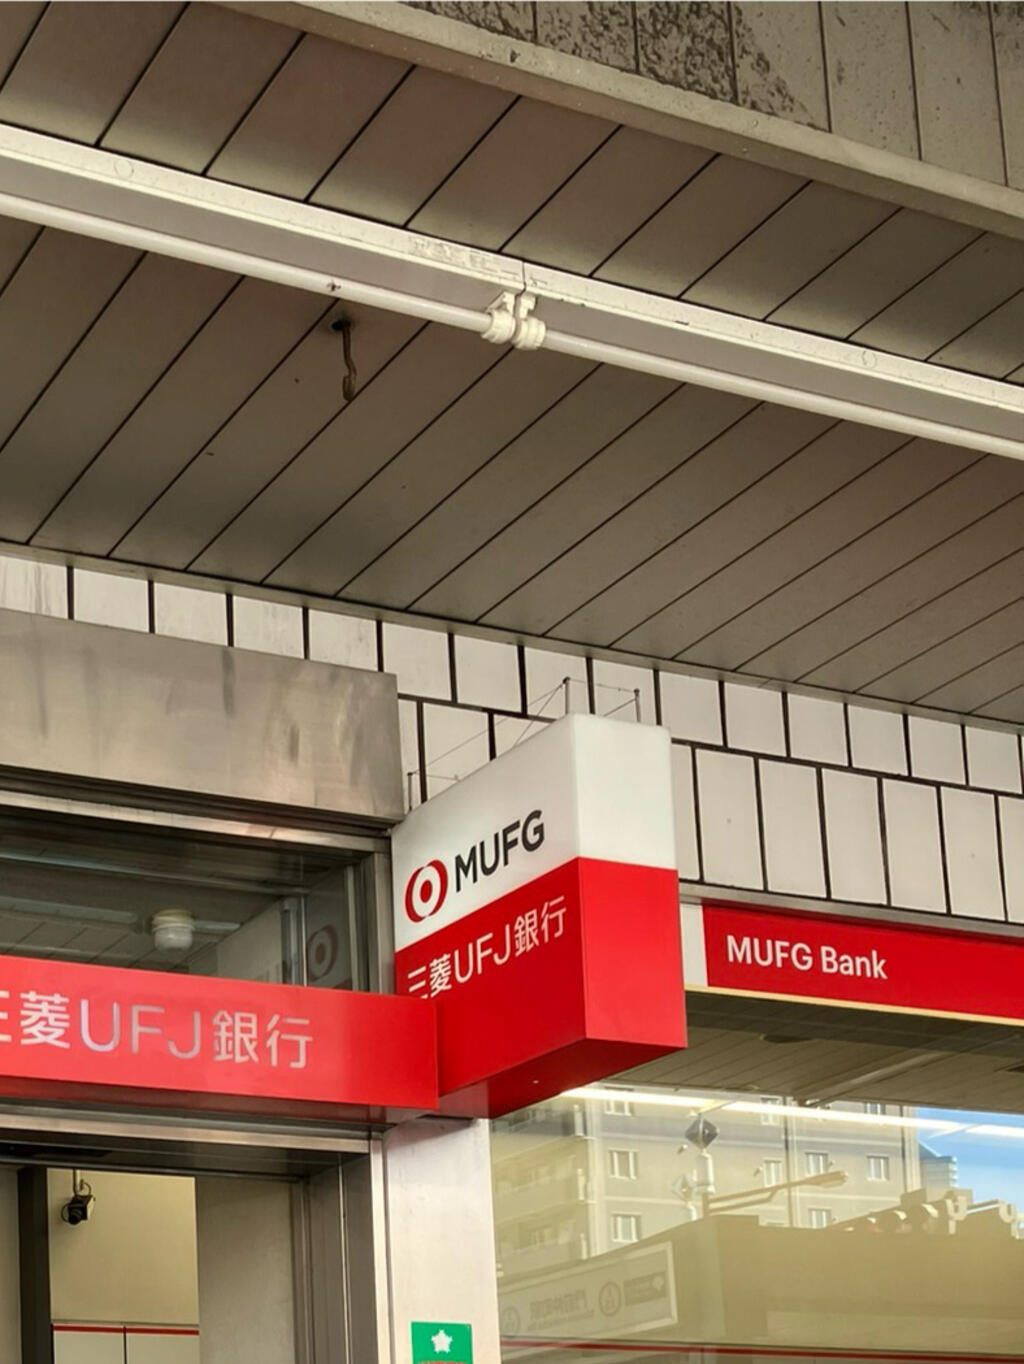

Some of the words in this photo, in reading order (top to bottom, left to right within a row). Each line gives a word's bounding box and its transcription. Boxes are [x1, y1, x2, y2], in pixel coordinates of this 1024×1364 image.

[454, 809, 545, 893] MUFG
[408, 895, 567, 999] 三菱UFJ銀行
[727, 935, 813, 971] MUFG
[820, 945, 888, 980] Bank
